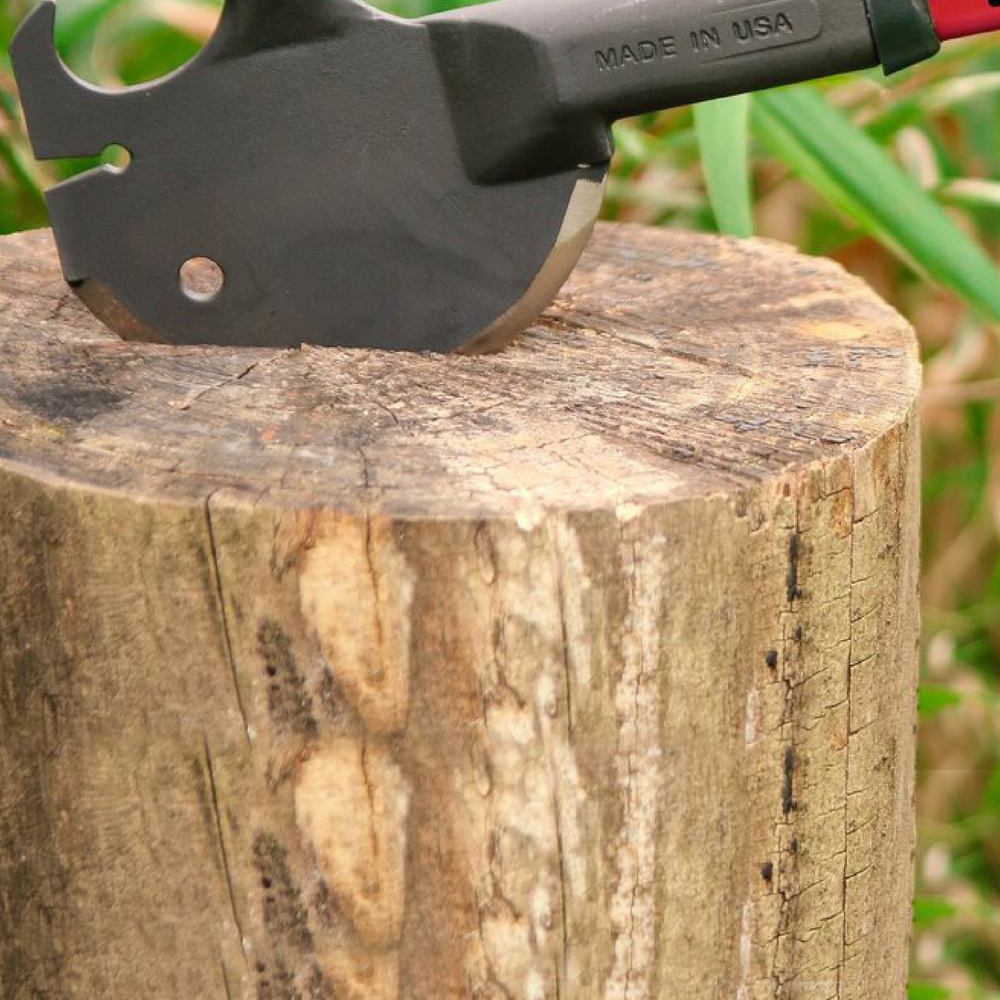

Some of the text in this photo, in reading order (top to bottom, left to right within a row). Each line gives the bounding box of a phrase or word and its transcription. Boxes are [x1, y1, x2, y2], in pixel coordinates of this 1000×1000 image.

[594, 12, 794, 71] MADE IN USA
